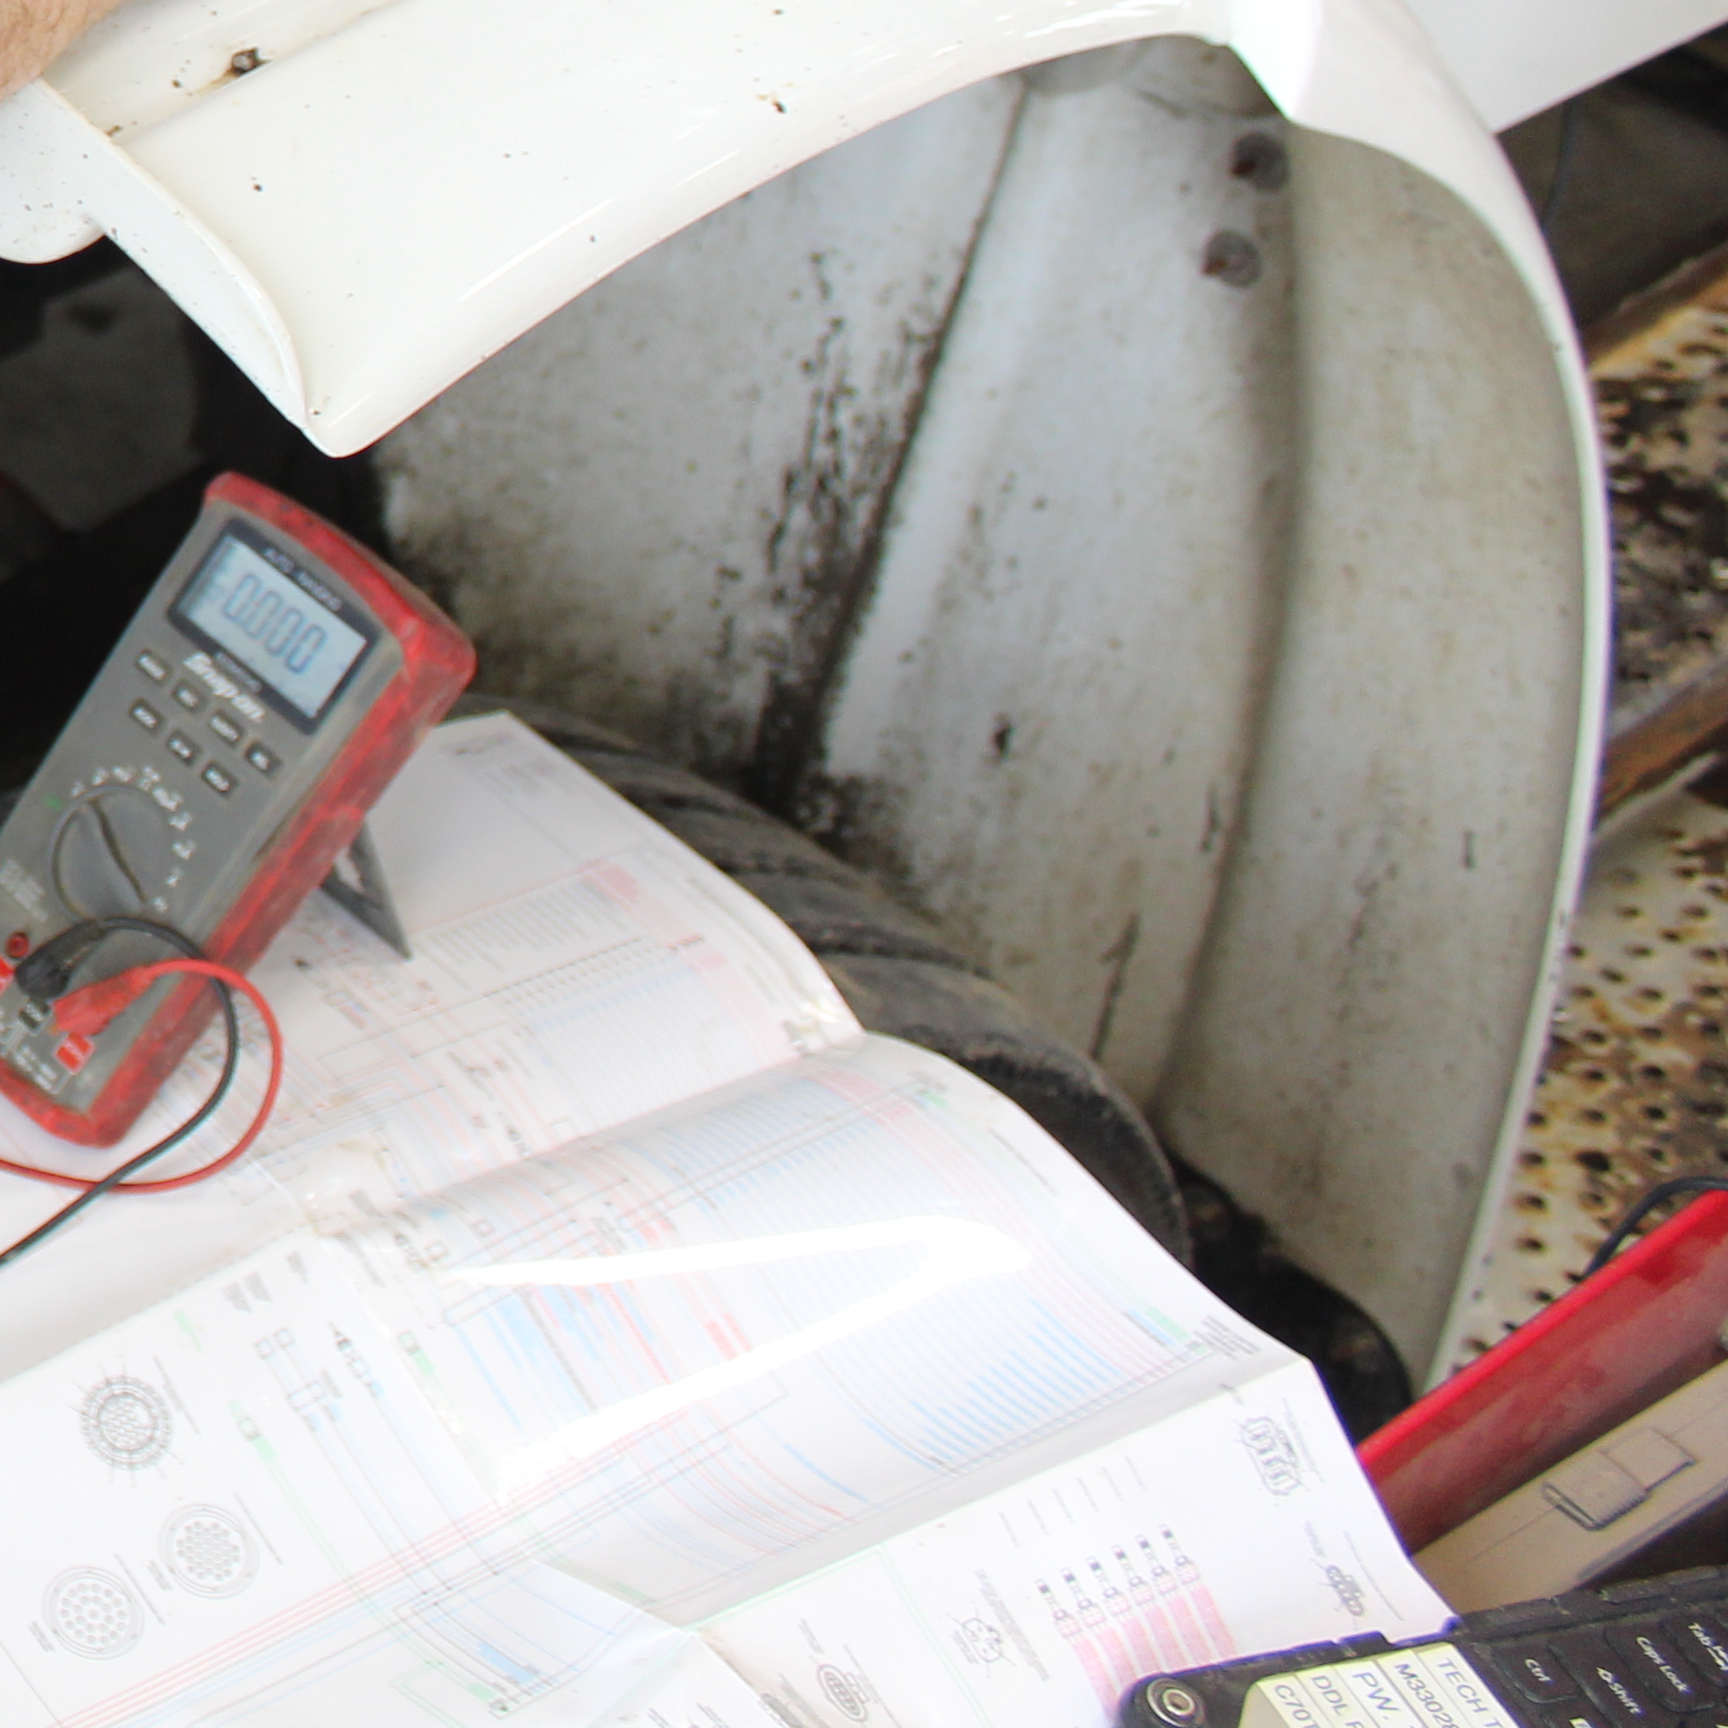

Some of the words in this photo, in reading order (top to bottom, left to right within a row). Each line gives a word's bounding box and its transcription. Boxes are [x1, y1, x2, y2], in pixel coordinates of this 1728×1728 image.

[1688, 1622, 1715, 1647] Tab
[1524, 1658, 1553, 1683] Ctrl
[1636, 1636, 1666, 1665] Caps
[1658, 1665, 1690, 1693] Lock
[1310, 1674, 1349, 1717] DDL
[1436, 1657, 1489, 1714] TECH
[1609, 1678, 1642, 1715] Shift
